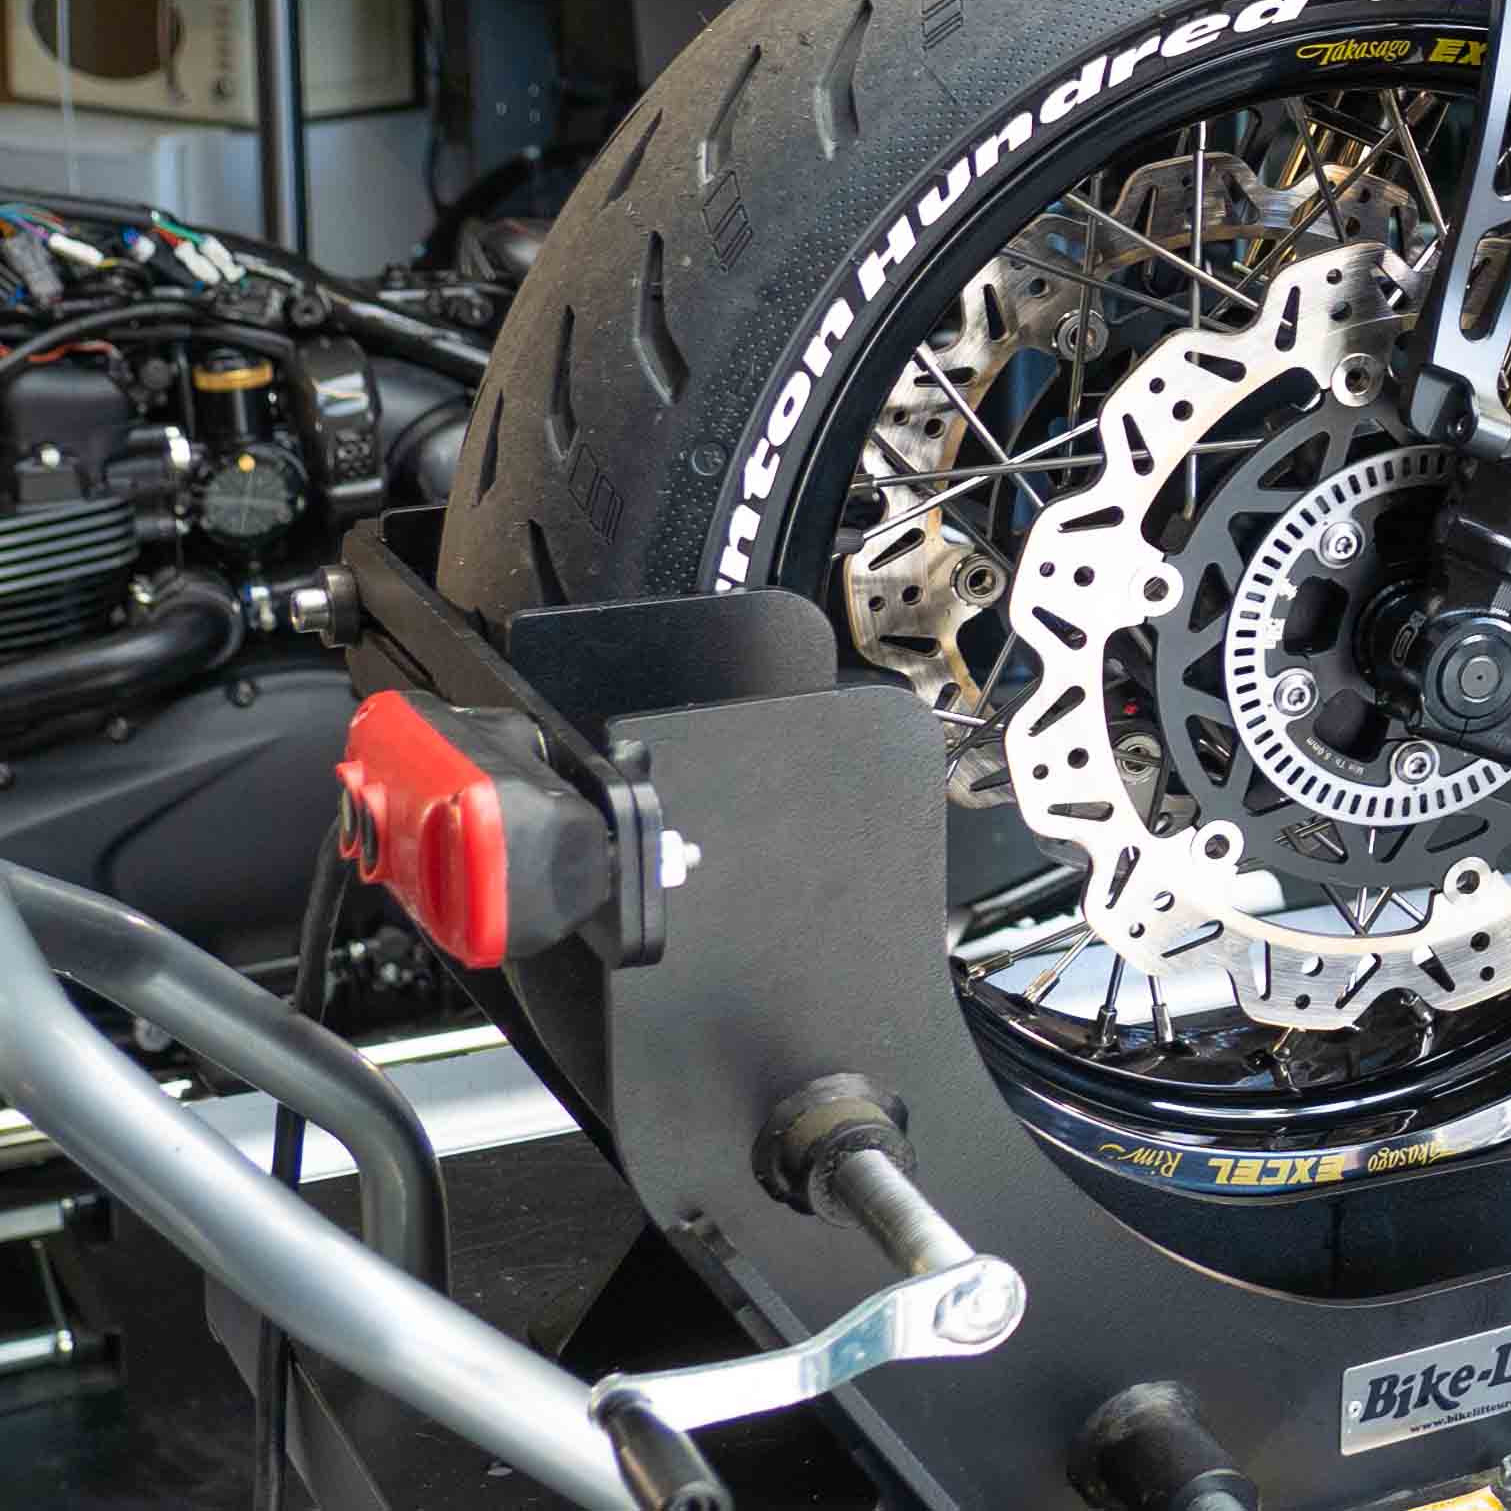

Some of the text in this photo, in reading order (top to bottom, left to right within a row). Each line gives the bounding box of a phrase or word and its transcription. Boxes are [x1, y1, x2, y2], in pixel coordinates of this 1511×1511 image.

[1295, 38, 1412, 66] Takasago
[715, 296, 855, 591] nton
[1206, 1154, 1345, 1186] EXCEL
